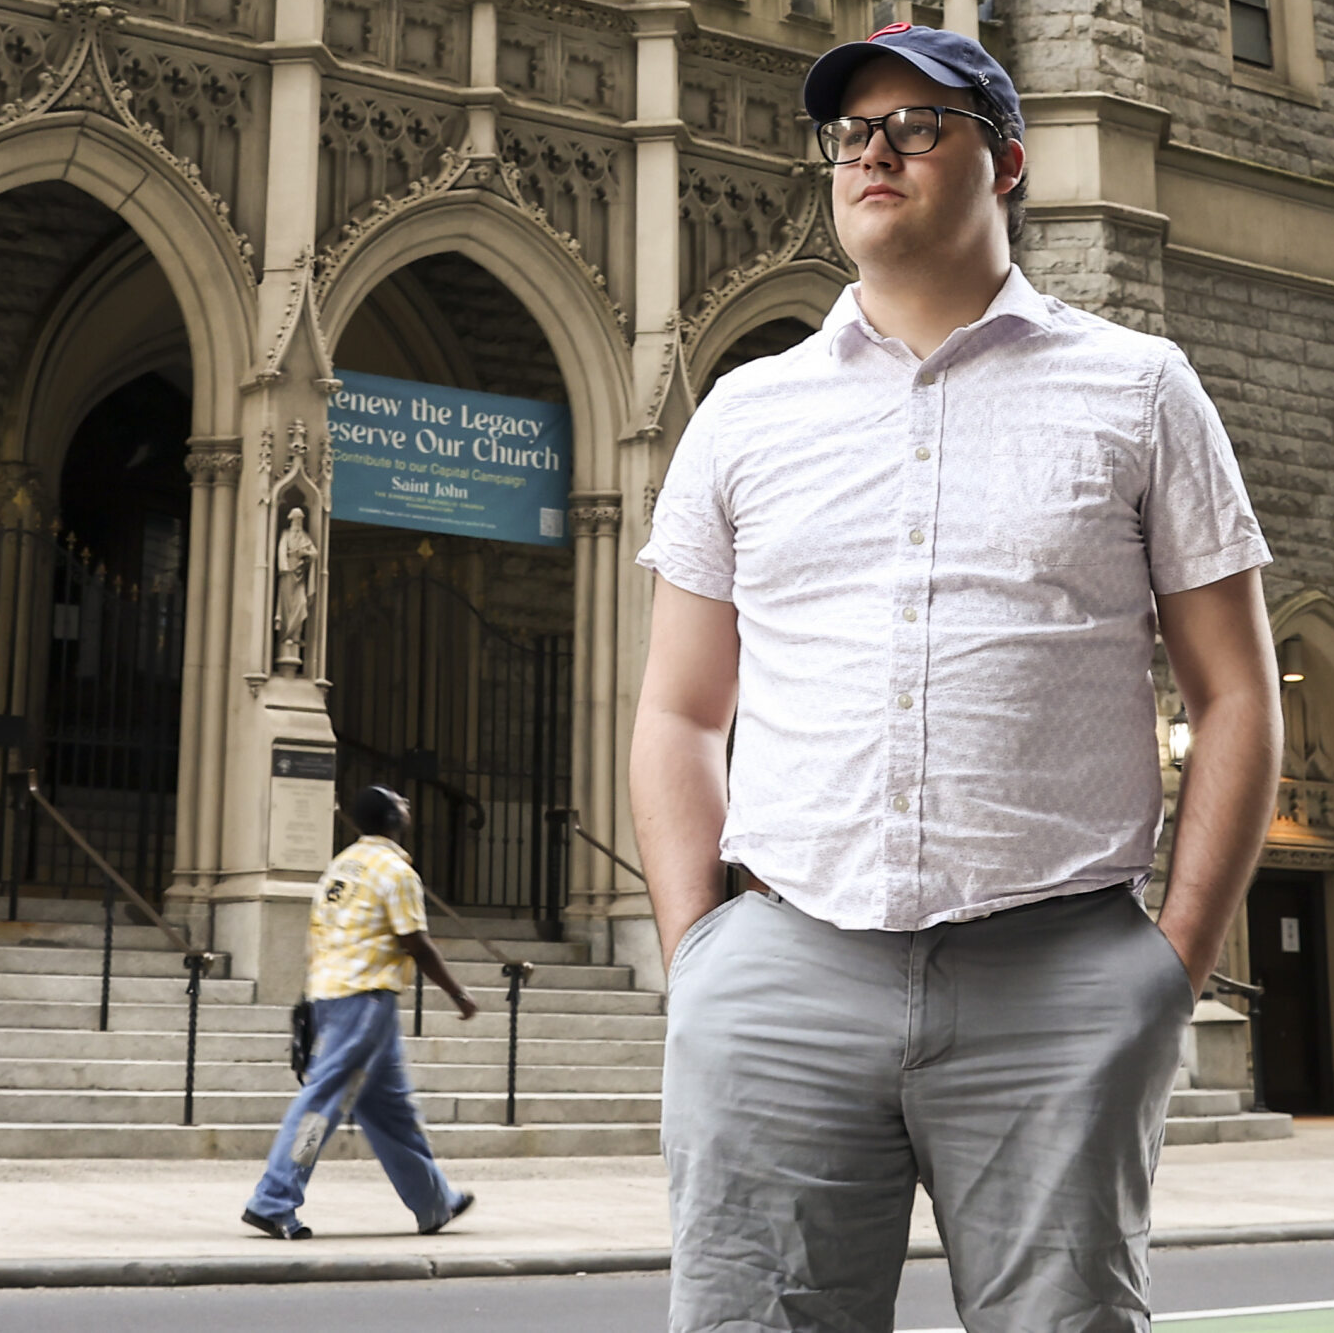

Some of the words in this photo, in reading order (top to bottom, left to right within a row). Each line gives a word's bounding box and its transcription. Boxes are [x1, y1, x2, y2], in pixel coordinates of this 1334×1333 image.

[411, 398, 452, 426] the
[461, 404, 543, 444] Legacy
[332, 449, 392, 468] Contribute
[395, 458, 405, 471] to
[409, 462, 427, 474] our
[430, 463, 470, 479] Capital
[471, 469, 527, 488] Campaign
[415, 429, 464, 458] Our
[472, 437, 560, 471] Church
[392, 476, 429, 494] Saint
[433, 482, 469, 499] John
